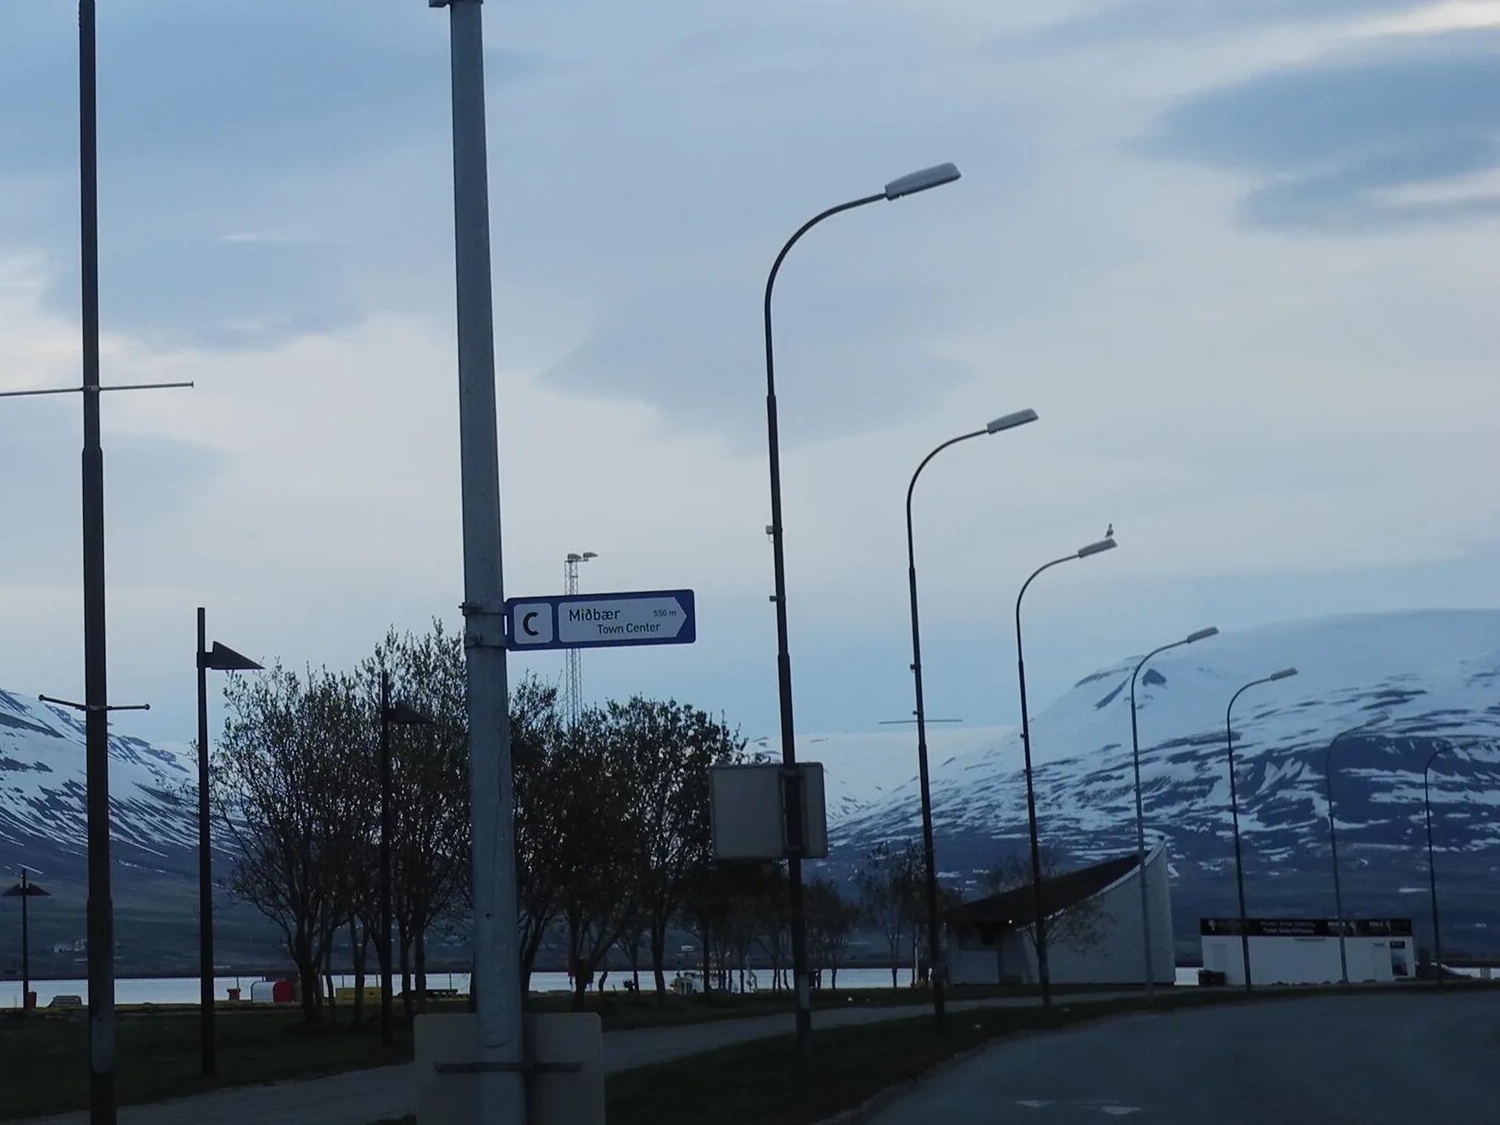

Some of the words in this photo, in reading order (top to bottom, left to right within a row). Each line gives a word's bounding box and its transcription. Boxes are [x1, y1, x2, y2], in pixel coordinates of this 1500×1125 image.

[568, 608, 621, 622] Miðbær
[522, 611, 539, 637] C
[597, 623, 624, 635] Town
[626, 622, 661, 633] Center
